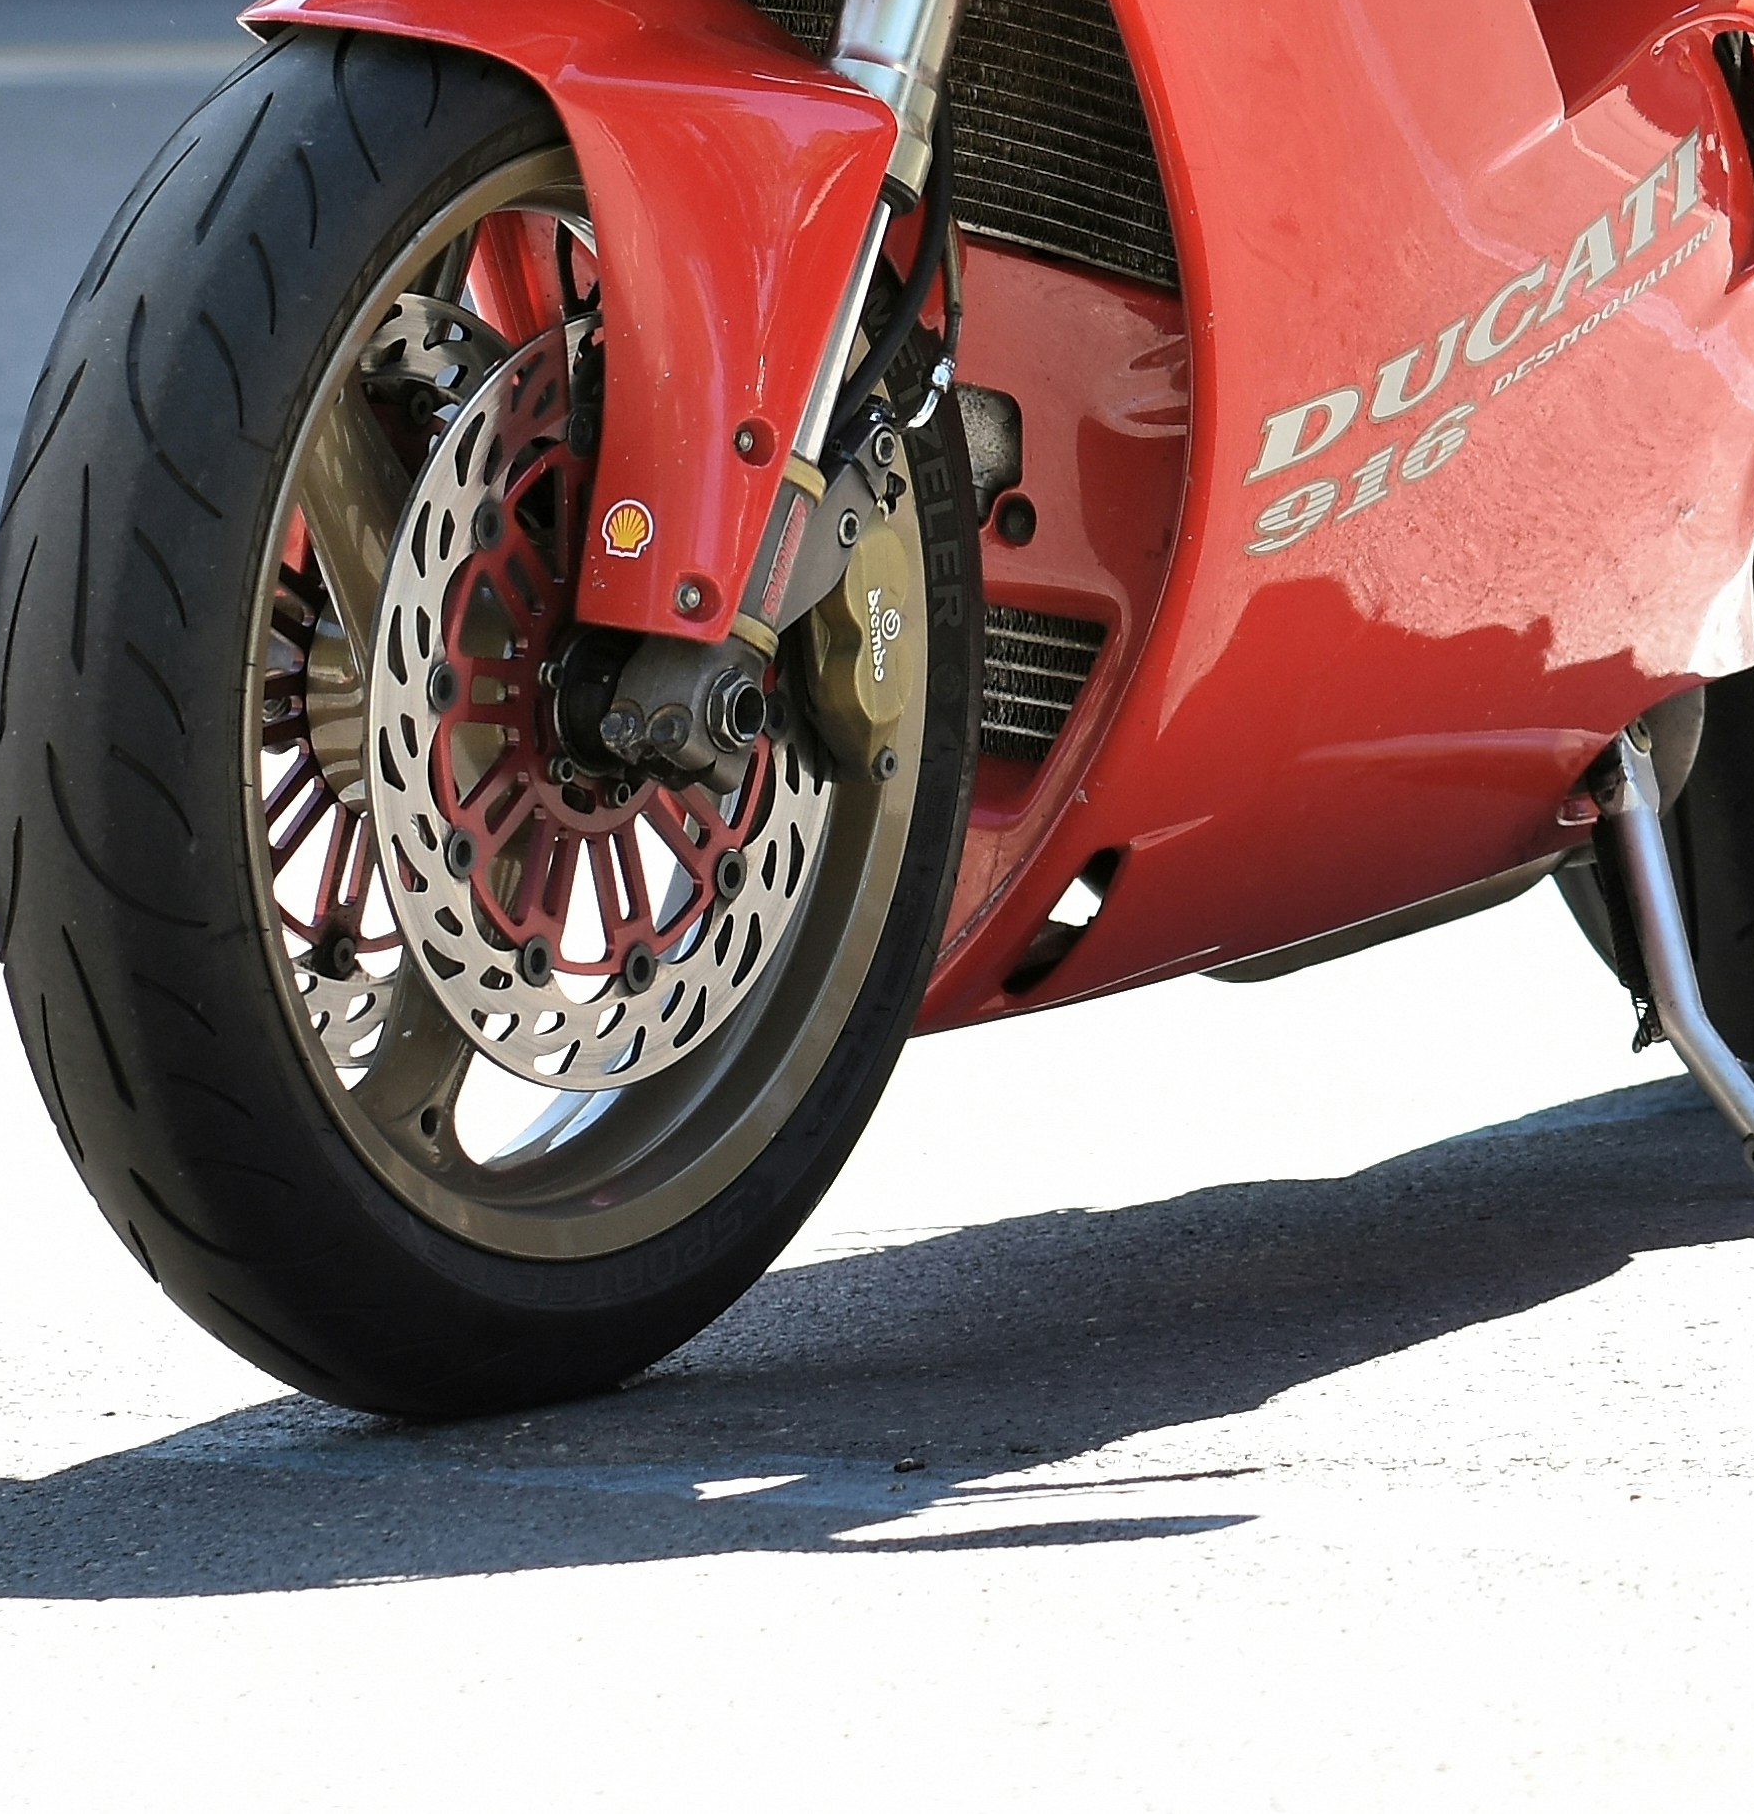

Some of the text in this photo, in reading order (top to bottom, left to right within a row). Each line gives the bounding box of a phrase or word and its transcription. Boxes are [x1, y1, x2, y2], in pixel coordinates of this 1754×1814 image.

[1243, 126, 1702, 487] DUCATI
[1488, 218, 1717, 398] DESMOQUATTRO
[1244, 403, 1475, 557] 916
[866, 587, 887, 682] brembo
